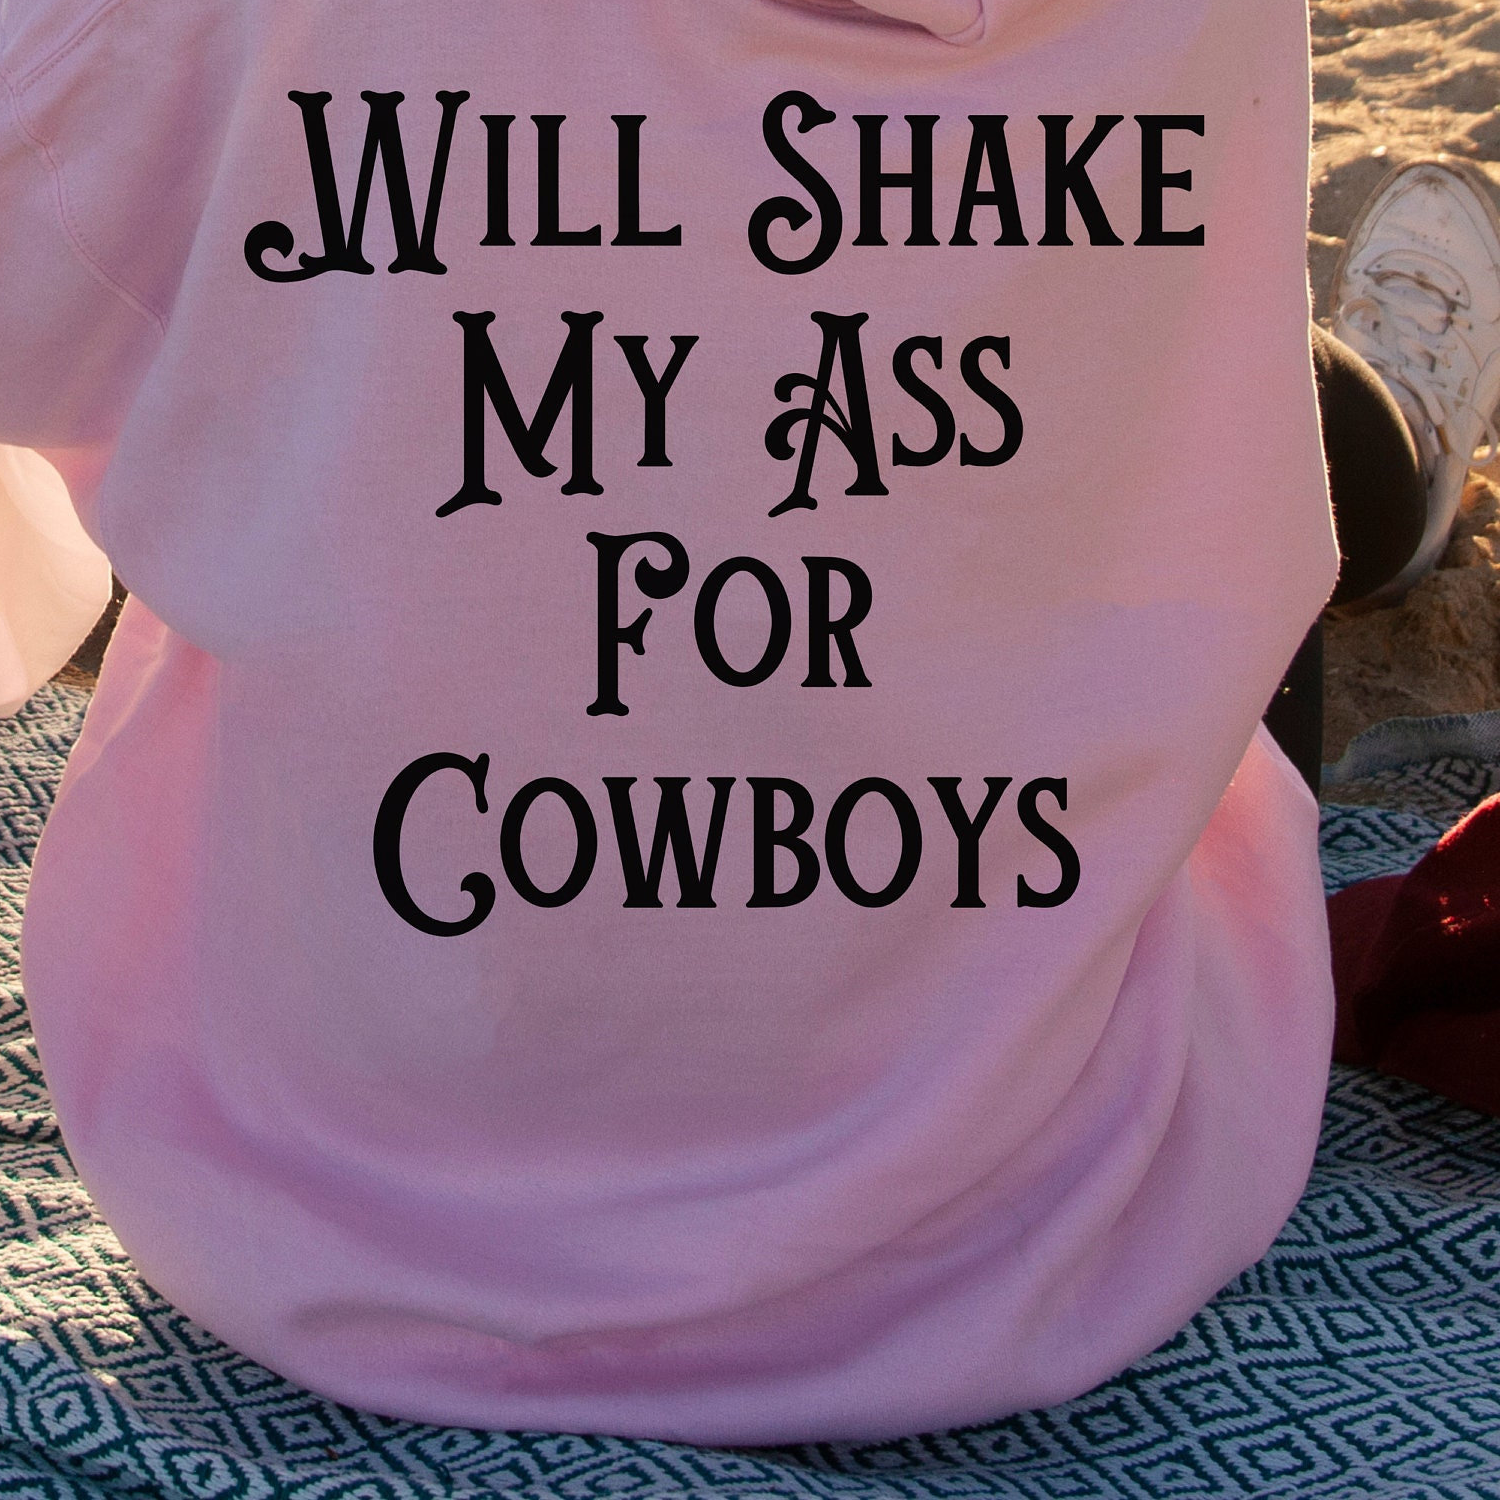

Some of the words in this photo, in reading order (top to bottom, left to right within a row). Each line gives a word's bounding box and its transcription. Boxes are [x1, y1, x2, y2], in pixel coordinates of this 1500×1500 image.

[243, 90, 682, 283] WILL
[747, 90, 1205, 275] SHAKE
[435, 310, 700, 518] MY
[764, 310, 1024, 518] ASS
[586, 531, 873, 717] FOR
[372, 751, 1081, 938] COWBOYS
